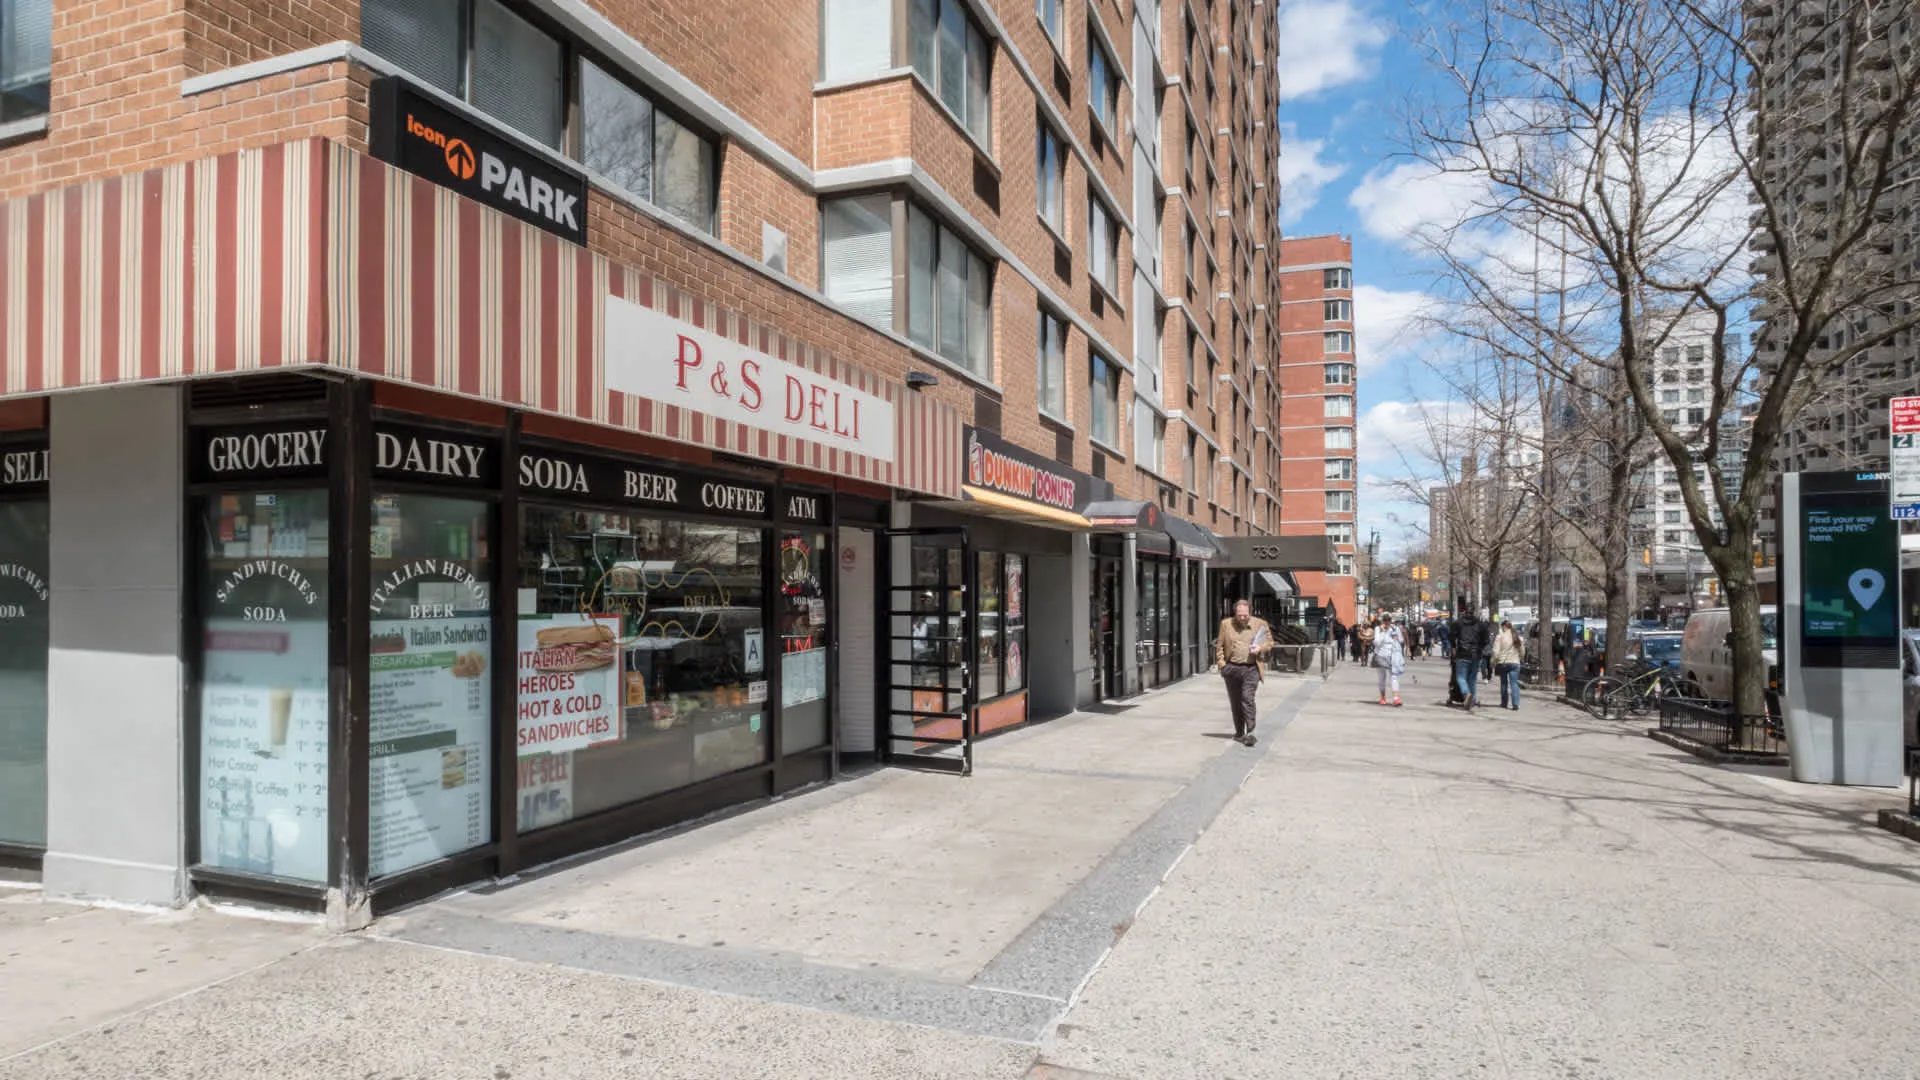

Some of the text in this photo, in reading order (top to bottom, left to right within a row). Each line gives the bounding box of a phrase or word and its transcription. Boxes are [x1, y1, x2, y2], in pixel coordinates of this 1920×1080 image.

[407, 113, 446, 148] icon
[480, 151, 579, 231] PARK
[673, 334, 861, 440] P & S DELI
[208, 429, 327, 473] GROCERY
[375, 432, 486, 479] DAIRY
[1897, 434, 1909, 448] 2
[519, 455, 816, 519] SODA BEER COFFEE ATM
[983, 448, 1075, 510] DUNKIN' DONUTS
[1809, 516, 1831, 524] Find
[1809, 524, 1868, 533] around NYC
[216, 559, 318, 606] SANDWICHES
[369, 560, 490, 613] ITALIAN HEROS
[243, 605, 287, 622] SODA
[410, 603, 456, 619] BEER
[410, 626, 443, 647] Italian
[443, 623, 488, 645] Sandwich
[748, 638, 759, 660] A
[519, 649, 577, 670] ITALIAN
[519, 672, 576, 696] HEROES
[519, 693, 603, 721] HOT & COLD
[518, 715, 610, 747] SANDWICHES
